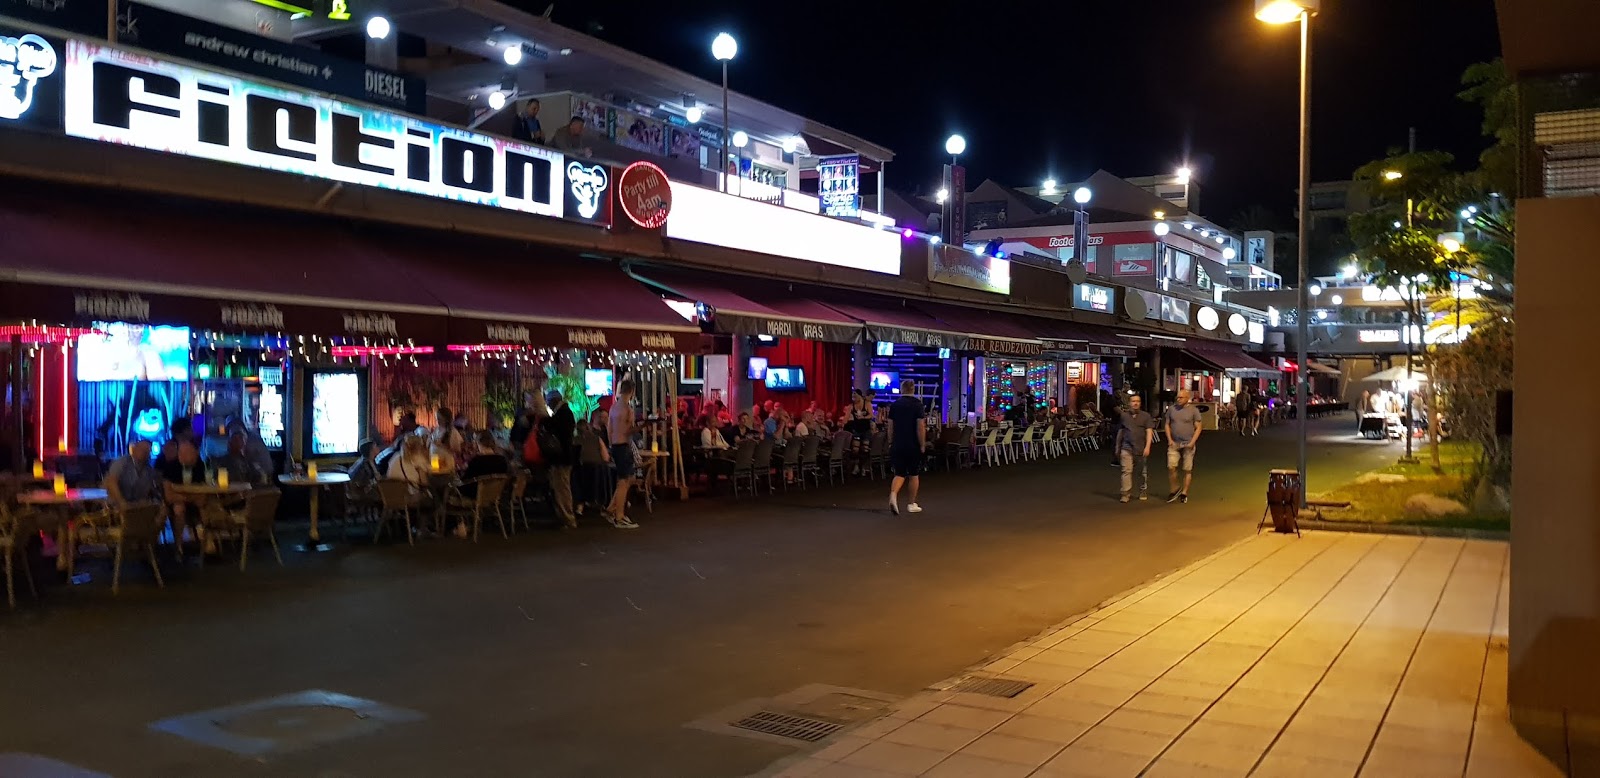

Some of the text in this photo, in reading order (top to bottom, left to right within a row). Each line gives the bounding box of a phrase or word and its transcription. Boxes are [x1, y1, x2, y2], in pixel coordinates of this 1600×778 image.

[184, 30, 319, 78] andrew christian
[364, 69, 408, 101] DIESEL
[624, 174, 659, 198] Party till
[637, 193, 662, 212] 4am
[1048, 236, 1067, 247] Foot
[767, 321, 824, 340] MARDI GRAS
[901, 330, 943, 346] MARDI GRAS
[969, 338, 986, 352] BAR
[988, 340, 1042, 356] RENDEZVOUS
